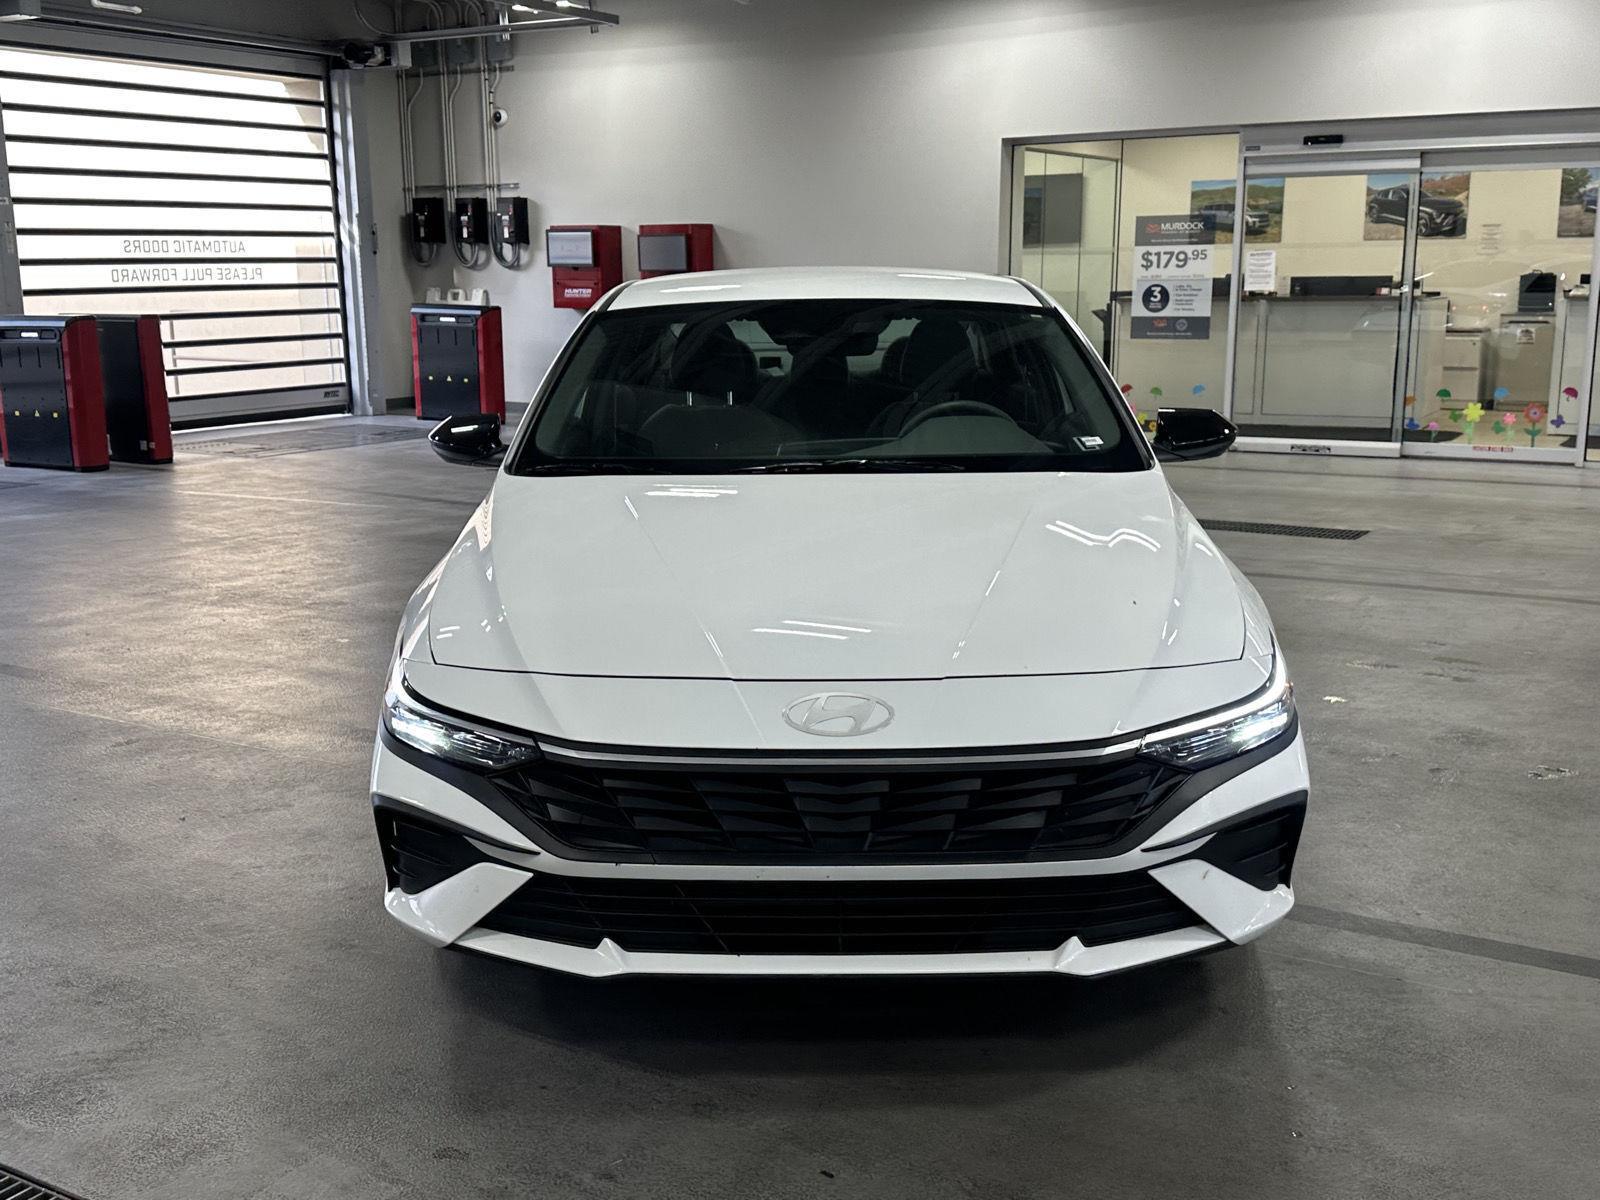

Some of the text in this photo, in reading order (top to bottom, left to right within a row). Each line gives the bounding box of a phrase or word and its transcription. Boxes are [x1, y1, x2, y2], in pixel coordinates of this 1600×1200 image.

[1161, 222, 1204, 230] MURDOCK
[1141, 249, 1207, 271] $179.95
[1150, 286, 1162, 301] 3
